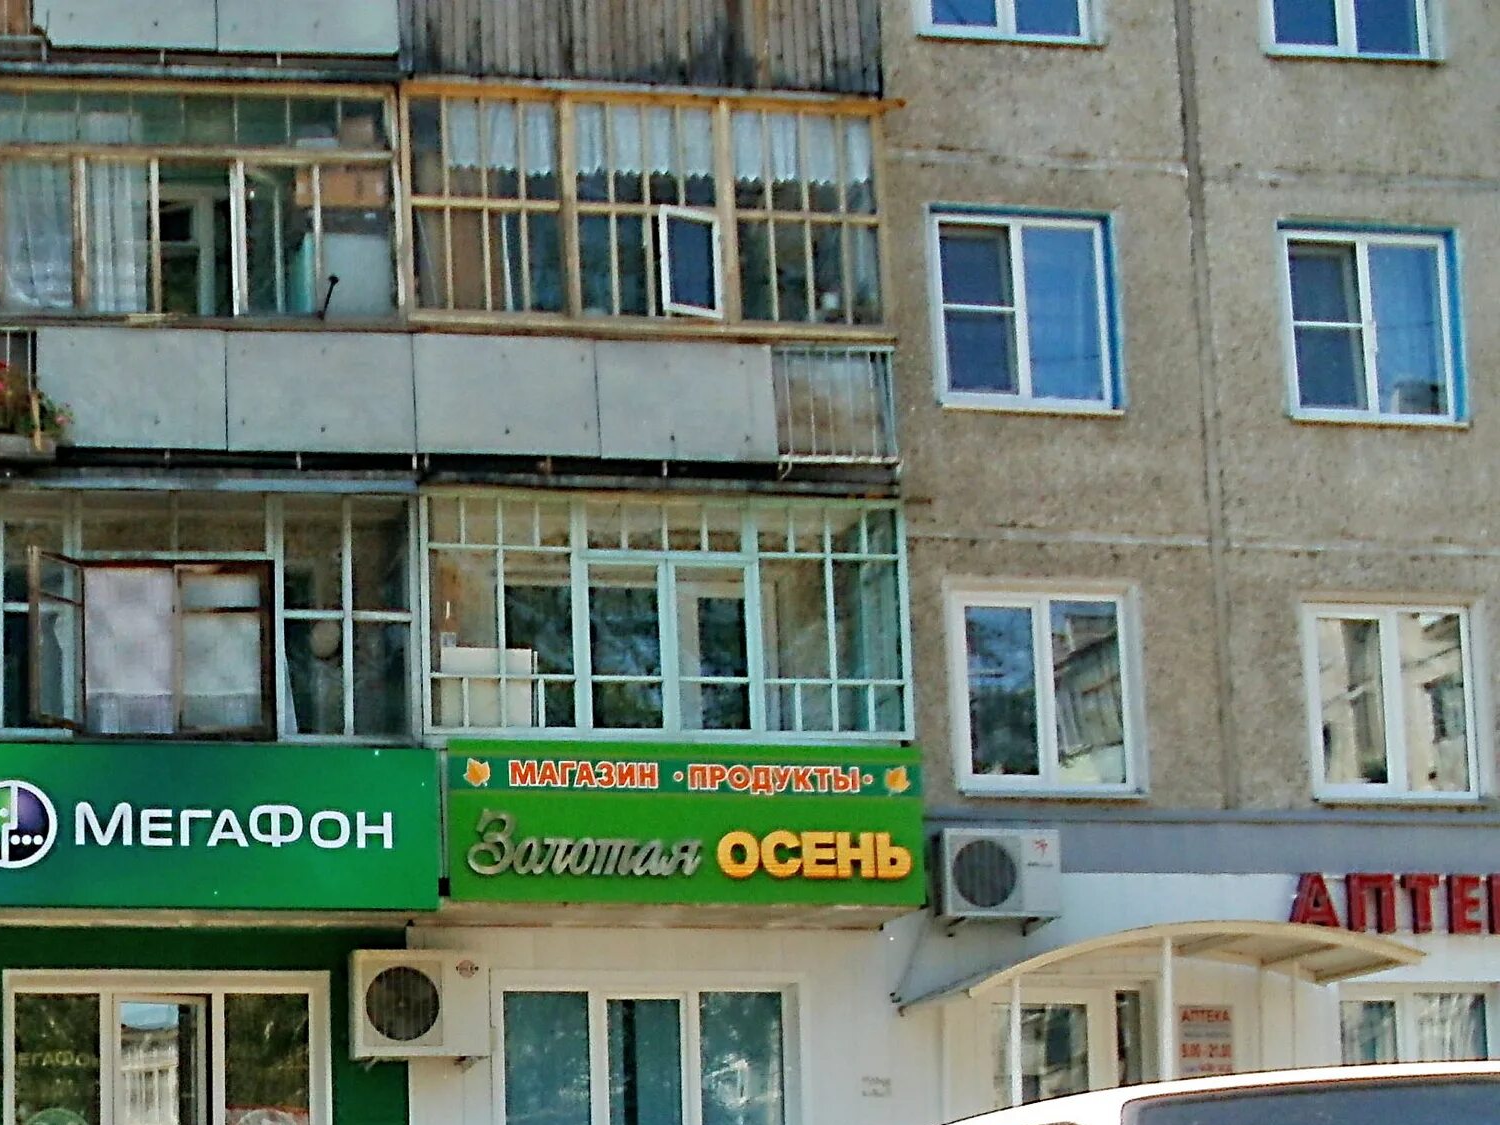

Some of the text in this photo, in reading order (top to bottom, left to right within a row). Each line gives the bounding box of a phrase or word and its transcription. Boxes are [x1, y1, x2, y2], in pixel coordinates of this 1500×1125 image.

[508, 759, 659, 789] МАГАЗИН
[466, 807, 914, 880] Золотая ОСЕНЬ
